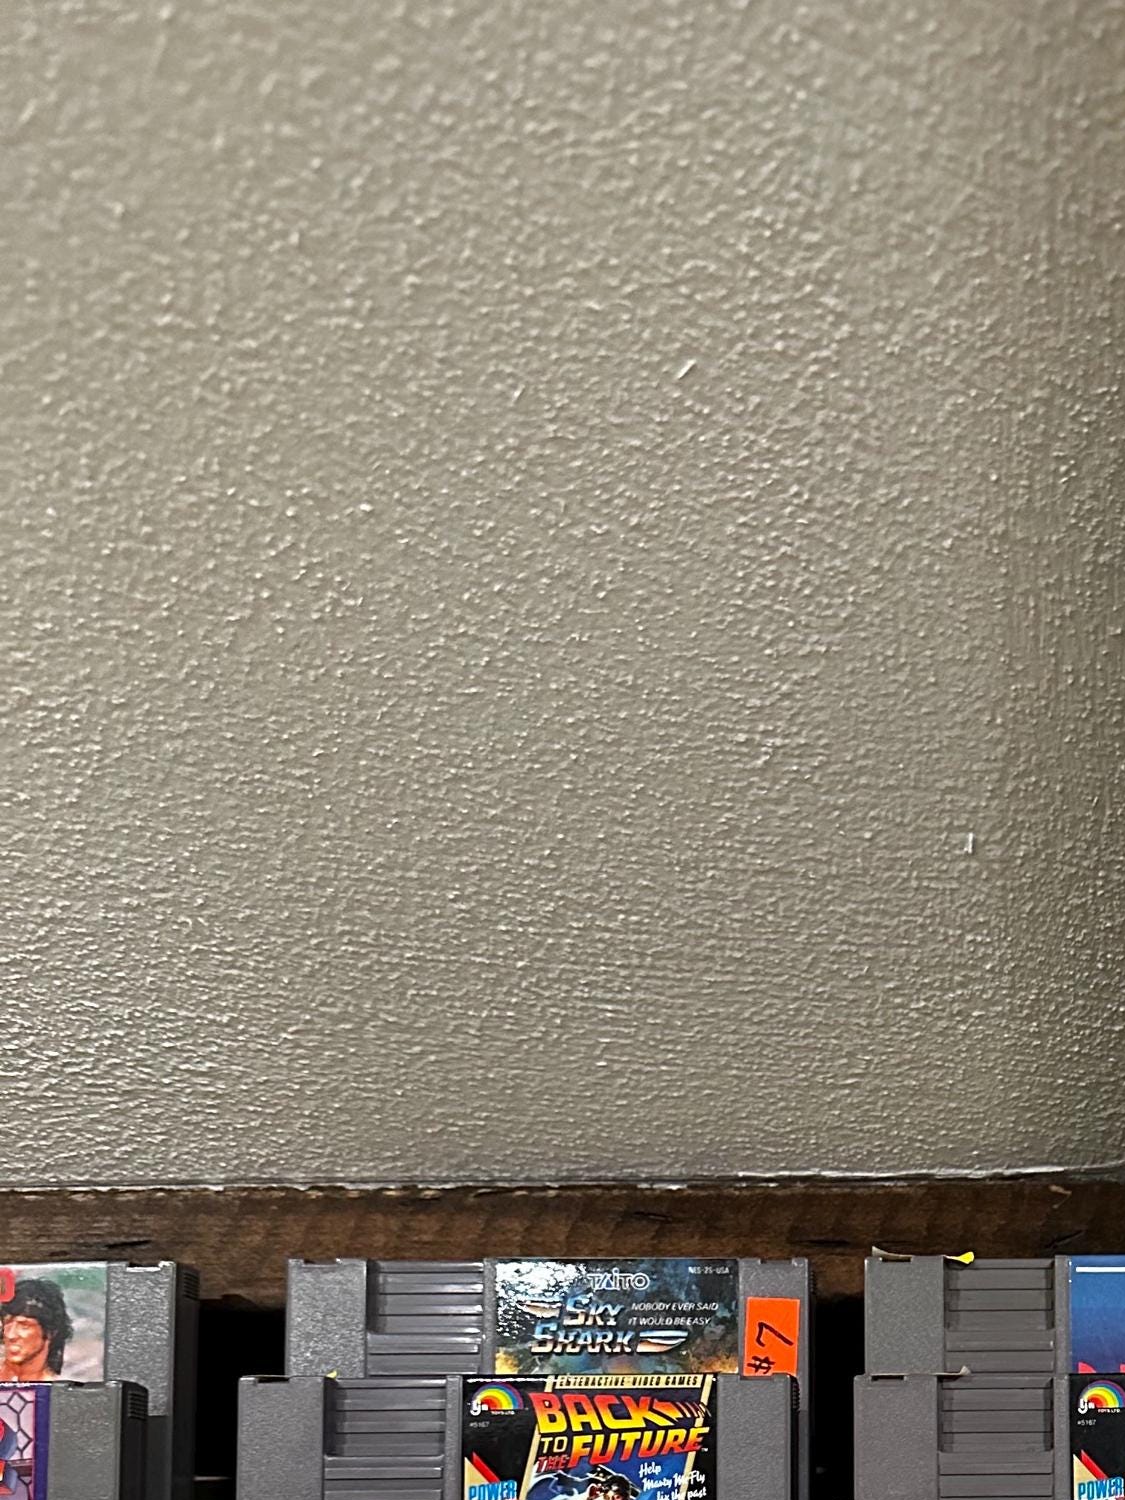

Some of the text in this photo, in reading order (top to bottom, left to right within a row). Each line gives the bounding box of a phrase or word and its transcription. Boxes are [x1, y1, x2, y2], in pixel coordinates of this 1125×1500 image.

[563, 1295, 624, 1326] SKY
[631, 1301, 719, 1312] NOBODY EVER SAID
[640, 1317, 672, 1326] WOULD
[686, 1316, 711, 1326] EASY
[531, 1321, 634, 1355] SHARK
[632, 1376, 662, 1387] VIDEO
[665, 1375, 698, 1387] GAMES
[528, 1392, 682, 1434] BACK
[540, 1437, 568, 1454] TO
[569, 1427, 710, 1469] FUTURE
[638, 1461, 662, 1478] Help
[687, 1486, 707, 1500] past
[1077, 1477, 1125, 1500] POWER
